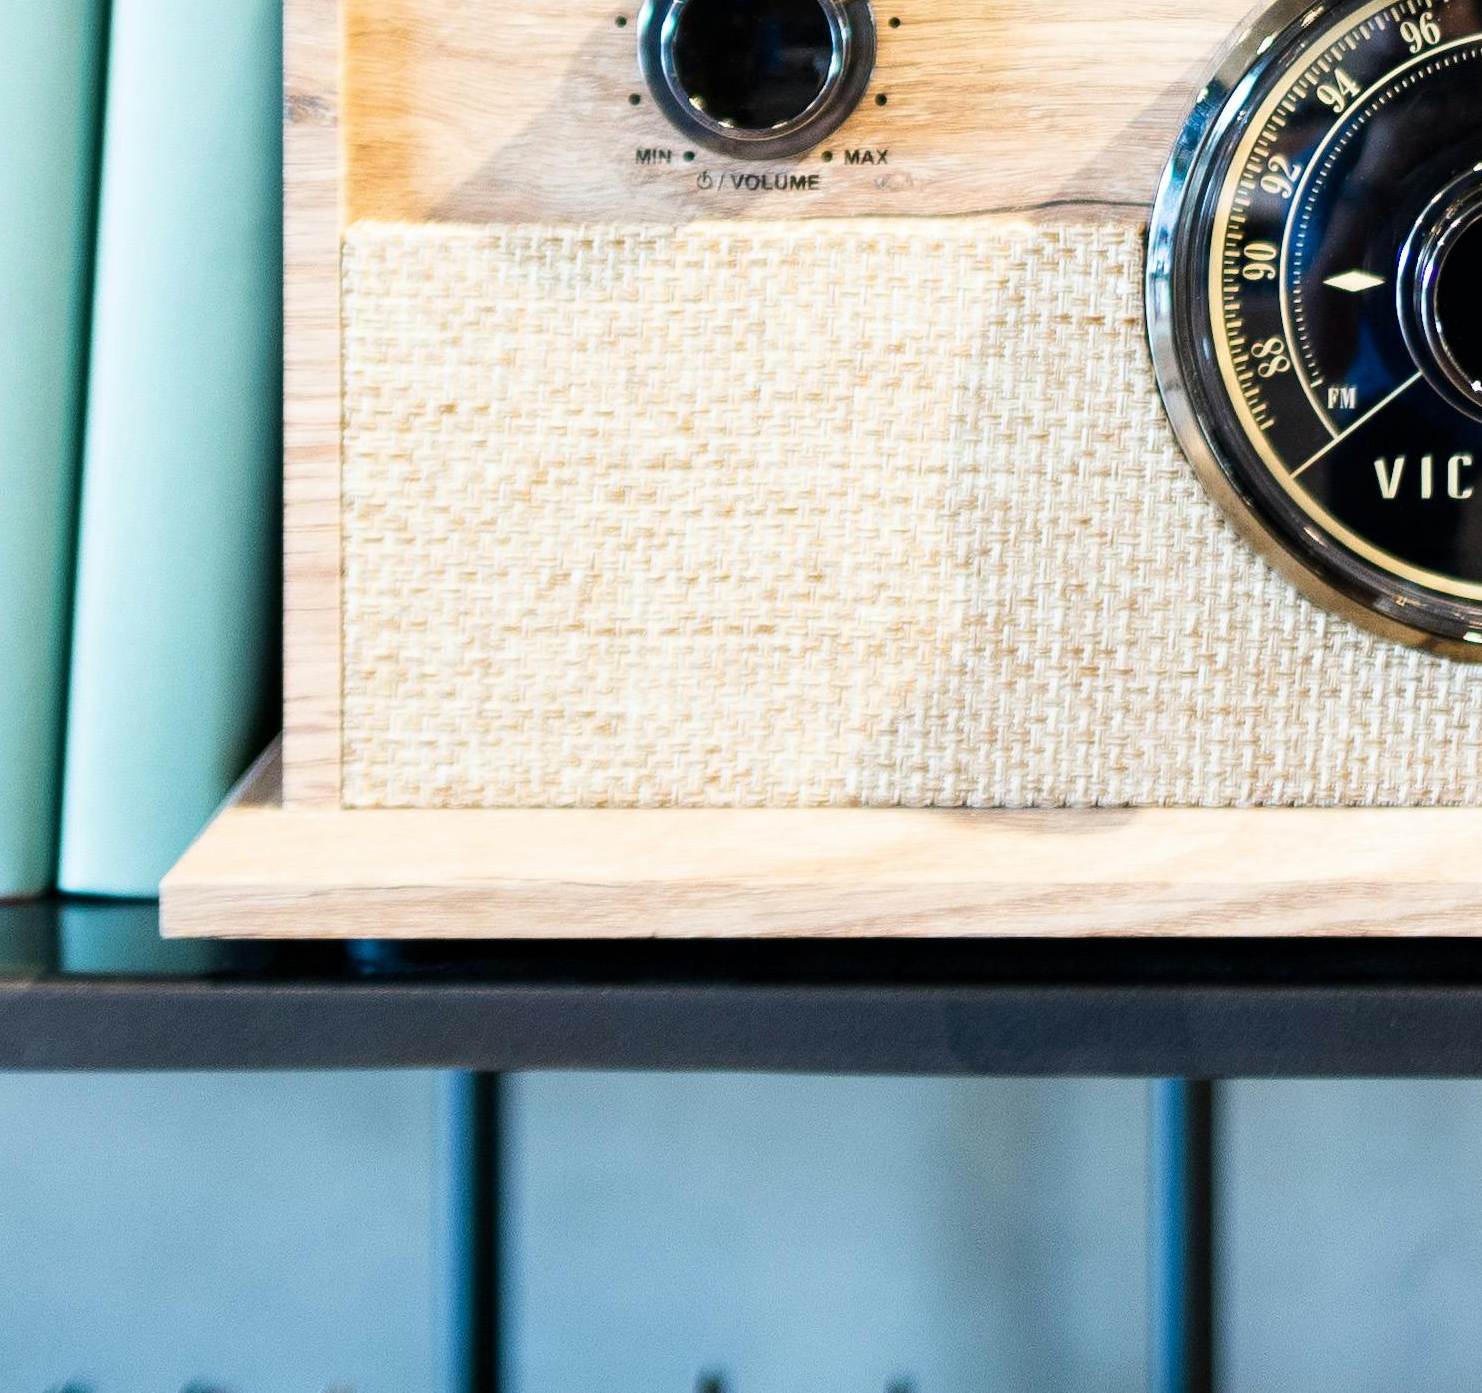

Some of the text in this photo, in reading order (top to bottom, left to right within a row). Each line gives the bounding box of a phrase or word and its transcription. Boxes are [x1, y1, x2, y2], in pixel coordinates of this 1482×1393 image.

[1399, 11, 1441, 54] 96
[1316, 68, 1361, 113] 94
[635, 149, 672, 165] MIN
[844, 149, 888, 165] MAX
[731, 174, 820, 191] VOLUME
[1260, 156, 1302, 199] 92
[1242, 243, 1277, 280] 90
[1251, 337, 1290, 378] 88
[1327, 387, 1357, 409] FM
